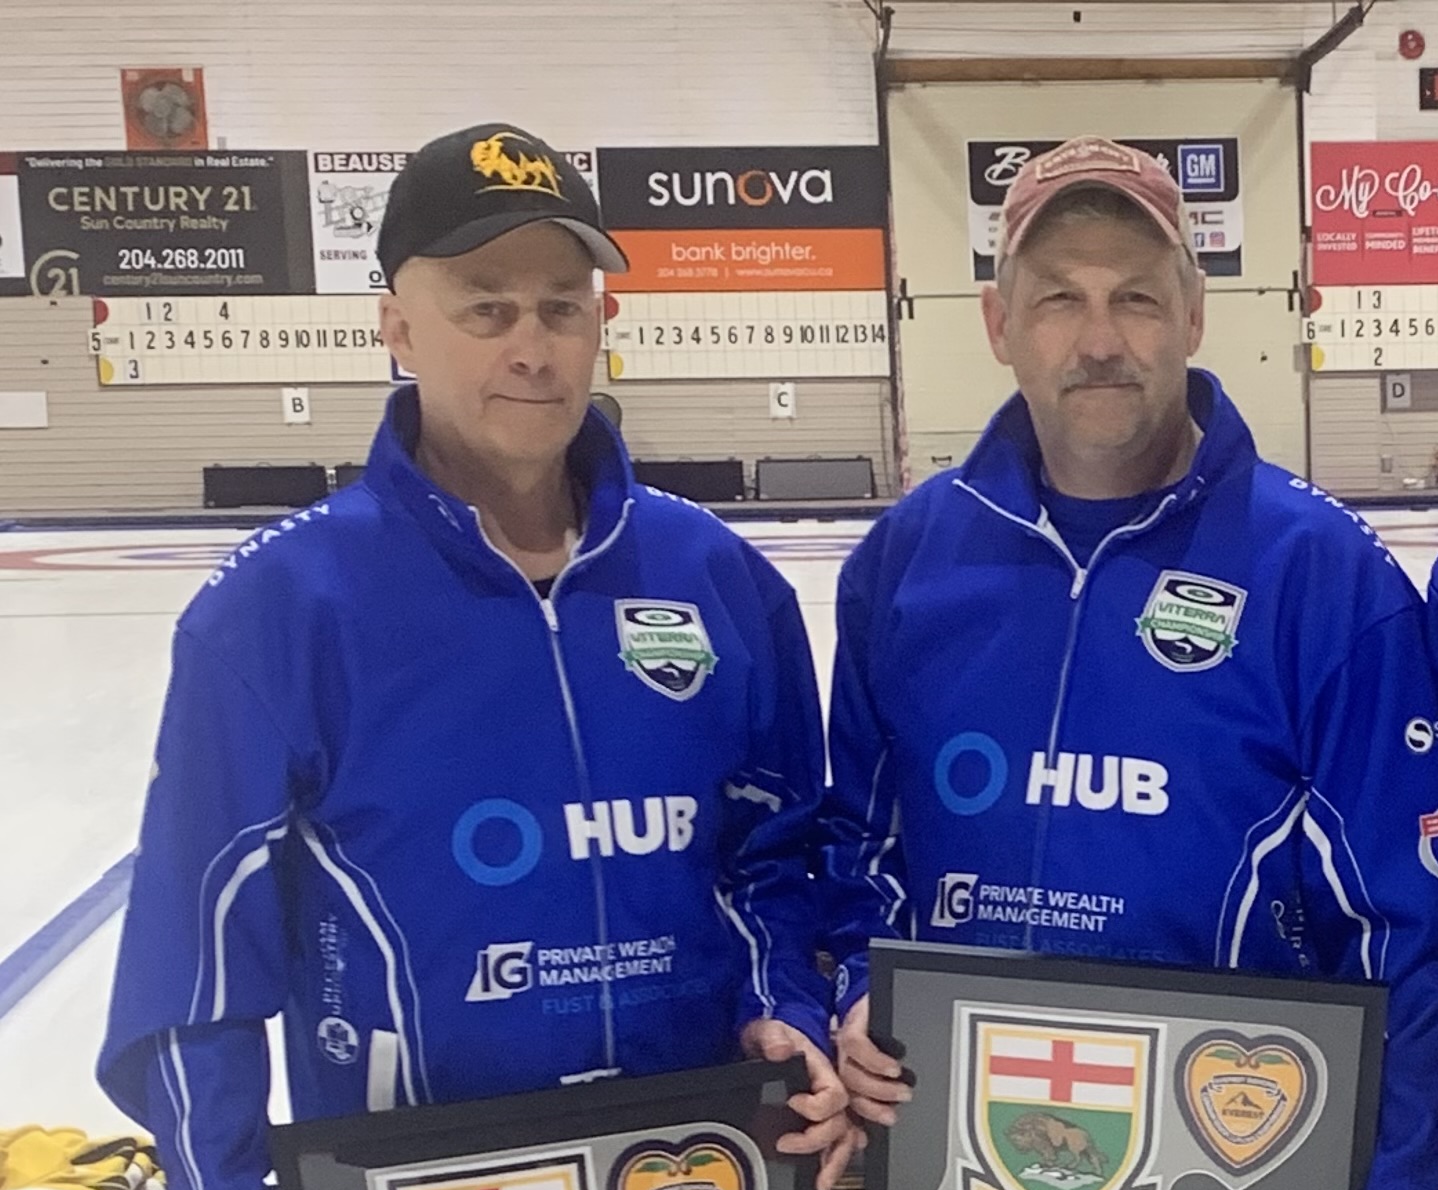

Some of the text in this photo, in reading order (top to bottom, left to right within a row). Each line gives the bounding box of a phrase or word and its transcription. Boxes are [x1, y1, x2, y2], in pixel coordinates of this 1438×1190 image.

[85, 157, 103, 167] the
[194, 157, 205, 167] in
[207, 157, 229, 167] Real
[1186, 153, 1216, 177] GM
[647, 169, 833, 207] sunova
[1316, 166, 1380, 217] My
[48, 186, 251, 212] CENTURY 21
[80, 216, 229, 232] Sun Country Realty
[1317, 232, 1357, 241] LOCALLY
[1365, 240, 1406, 250] MINDED
[118, 249, 245, 270] 204.268.2011
[320, 250, 367, 261] SERVING
[672, 242, 816, 265] bank brighter.
[1373, 291, 1381, 309] 3
[163, 302, 172, 321] 2
[219, 302, 229, 320] 4
[92, 332, 101, 351] 5
[146, 331, 155, 349] 2
[165, 331, 175, 349] 3
[184, 330, 195, 348] 4
[204, 330, 213, 349] 5
[222, 330, 233, 349] 6
[241, 330, 250, 348] 7
[260, 330, 270, 348] 8
[279, 330, 289, 348] 9
[295, 330, 310, 348] 10
[317, 330, 327, 347] 11
[334, 329, 347, 347] 12
[352, 329, 367, 347] 13
[370, 327, 386, 347] 14
[655, 327, 664, 345] 2
[673, 326, 683, 345] 3
[691, 326, 701, 344] 4
[711, 326, 720, 344] 5
[728, 326, 738, 344] 6
[746, 326, 754, 344] 7
[765, 325, 774, 343] 8
[783, 326, 793, 343] 9
[800, 325, 815, 344] 10
[819, 325, 829, 343] 11
[836, 325, 848, 343] 12
[854, 324, 868, 343] 13
[872, 324, 885, 342] 14
[1307, 321, 1315, 340] 6
[1356, 320, 1364, 337] 2
[1373, 319, 1382, 337] 3
[1389, 319, 1400, 336] 4
[1409, 318, 1418, 336] 5
[1425, 318, 1434, 335] 6
[1374, 347, 1382, 366] 2
[129, 360, 139, 379] 3
[777, 392, 788, 407] C
[1392, 382, 1405, 398] D
[292, 397, 304, 413] B
[208, 504, 329, 586] DYNASTY
[1159, 602, 1226, 624] VITERRA
[1025, 752, 1169, 816] HUB
[564, 795, 697, 859] HUB
[979, 884, 1043, 906] PRIVATE
[1048, 890, 1124, 914] WEALTH
[977, 905, 1107, 932] MANAGEMENT
[476, 942, 616, 994] IG PRIVATE
[1222, 1109, 1264, 1119] EVEREST
